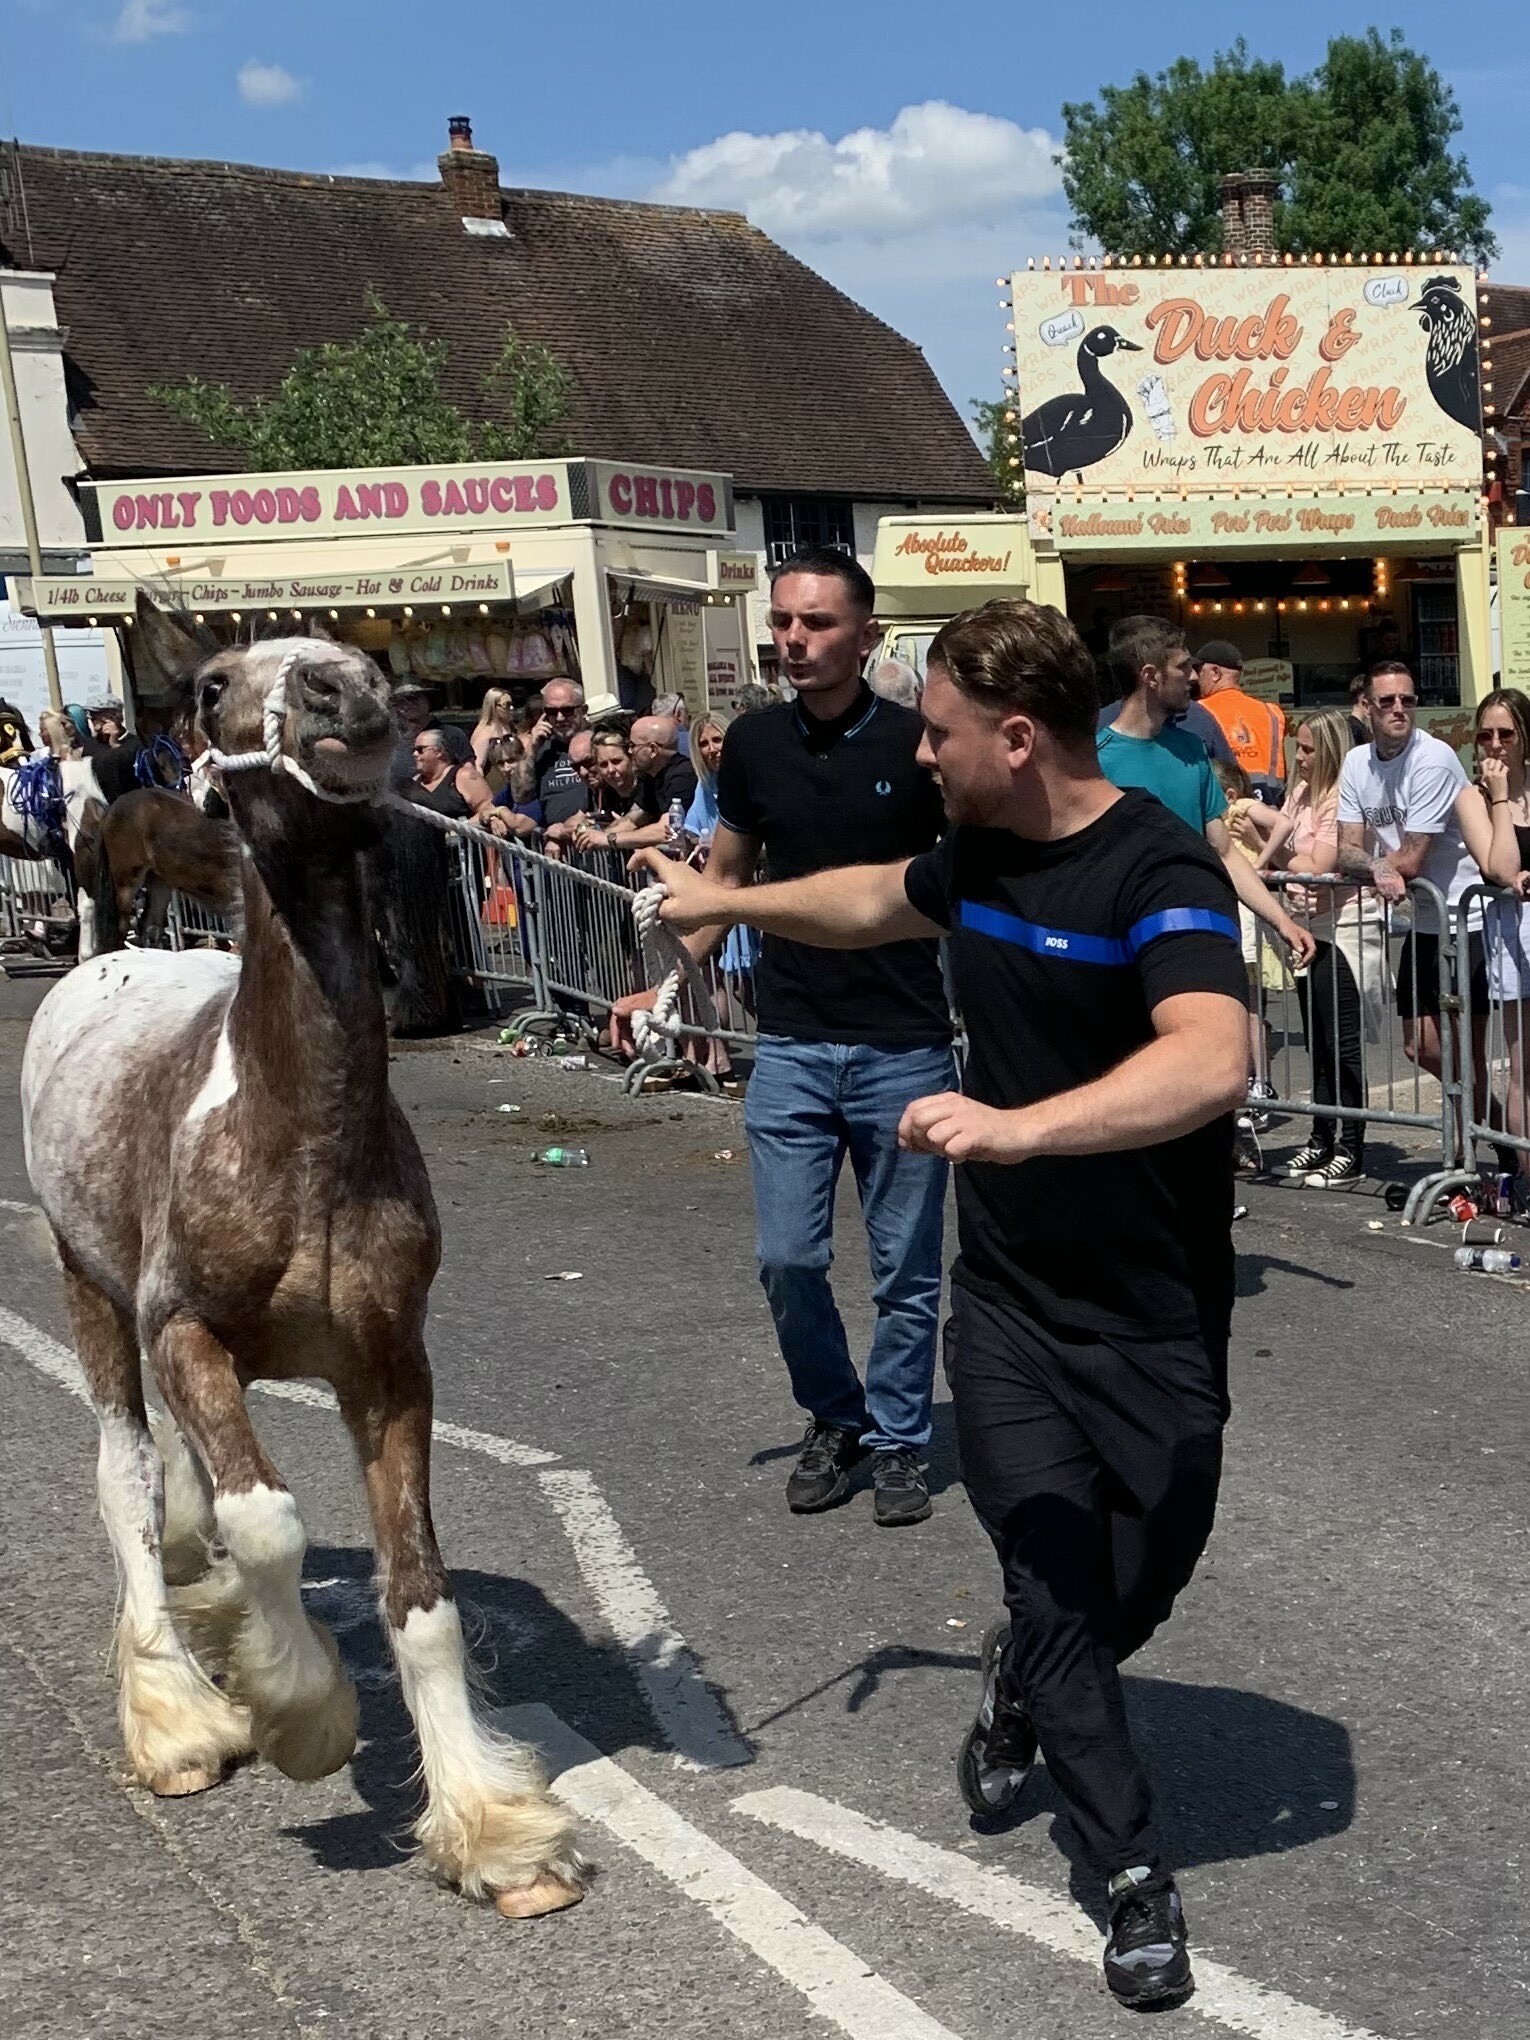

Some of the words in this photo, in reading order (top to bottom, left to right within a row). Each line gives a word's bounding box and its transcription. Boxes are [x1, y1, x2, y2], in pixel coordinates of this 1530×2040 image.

[1061, 274, 1140, 306] The
[1145, 293, 1304, 366] Duck
[1318, 307, 1363, 362] &
[1188, 366, 1408, 438] Chicken
[1143, 447, 1197, 476] Wraps
[1203, 444, 1246, 470] That
[1246, 444, 1283, 468] Are
[1286, 441, 1320, 470] All
[1325, 441, 1380, 467] About
[1382, 441, 1411, 467] The
[1416, 442, 1458, 467] Taste
[112, 491, 202, 531] ONLY
[209, 485, 322, 527] FOODS
[333, 481, 409, 521] AND
[420, 473, 559, 517] SAUCES
[608, 473, 717, 523] CHIPS
[1059, 511, 1145, 538] Halloumi
[1147, 511, 1192, 536] Fries
[1211, 508, 1251, 535] Peri
[1253, 507, 1293, 534] Peri
[1296, 507, 1356, 536] Wraps
[1375, 503, 1423, 530] Duck
[1426, 502, 1470, 528] Fries
[894, 530, 969, 557] Absolute
[720, 561, 755, 580] Drinks
[925, 550, 1012, 575] Quackers!
[47, 587, 80, 606] 1/4lb
[85, 587, 127, 605] Cheese
[191, 583, 229, 603] Chips
[241, 582, 285, 600] Jumbo
[289, 581, 343, 599] Sausage
[355, 578, 382, 595] Hot
[388, 577, 404, 594] &
[410, 575, 442, 593] Cold
[450, 573, 500, 592] Drinks
